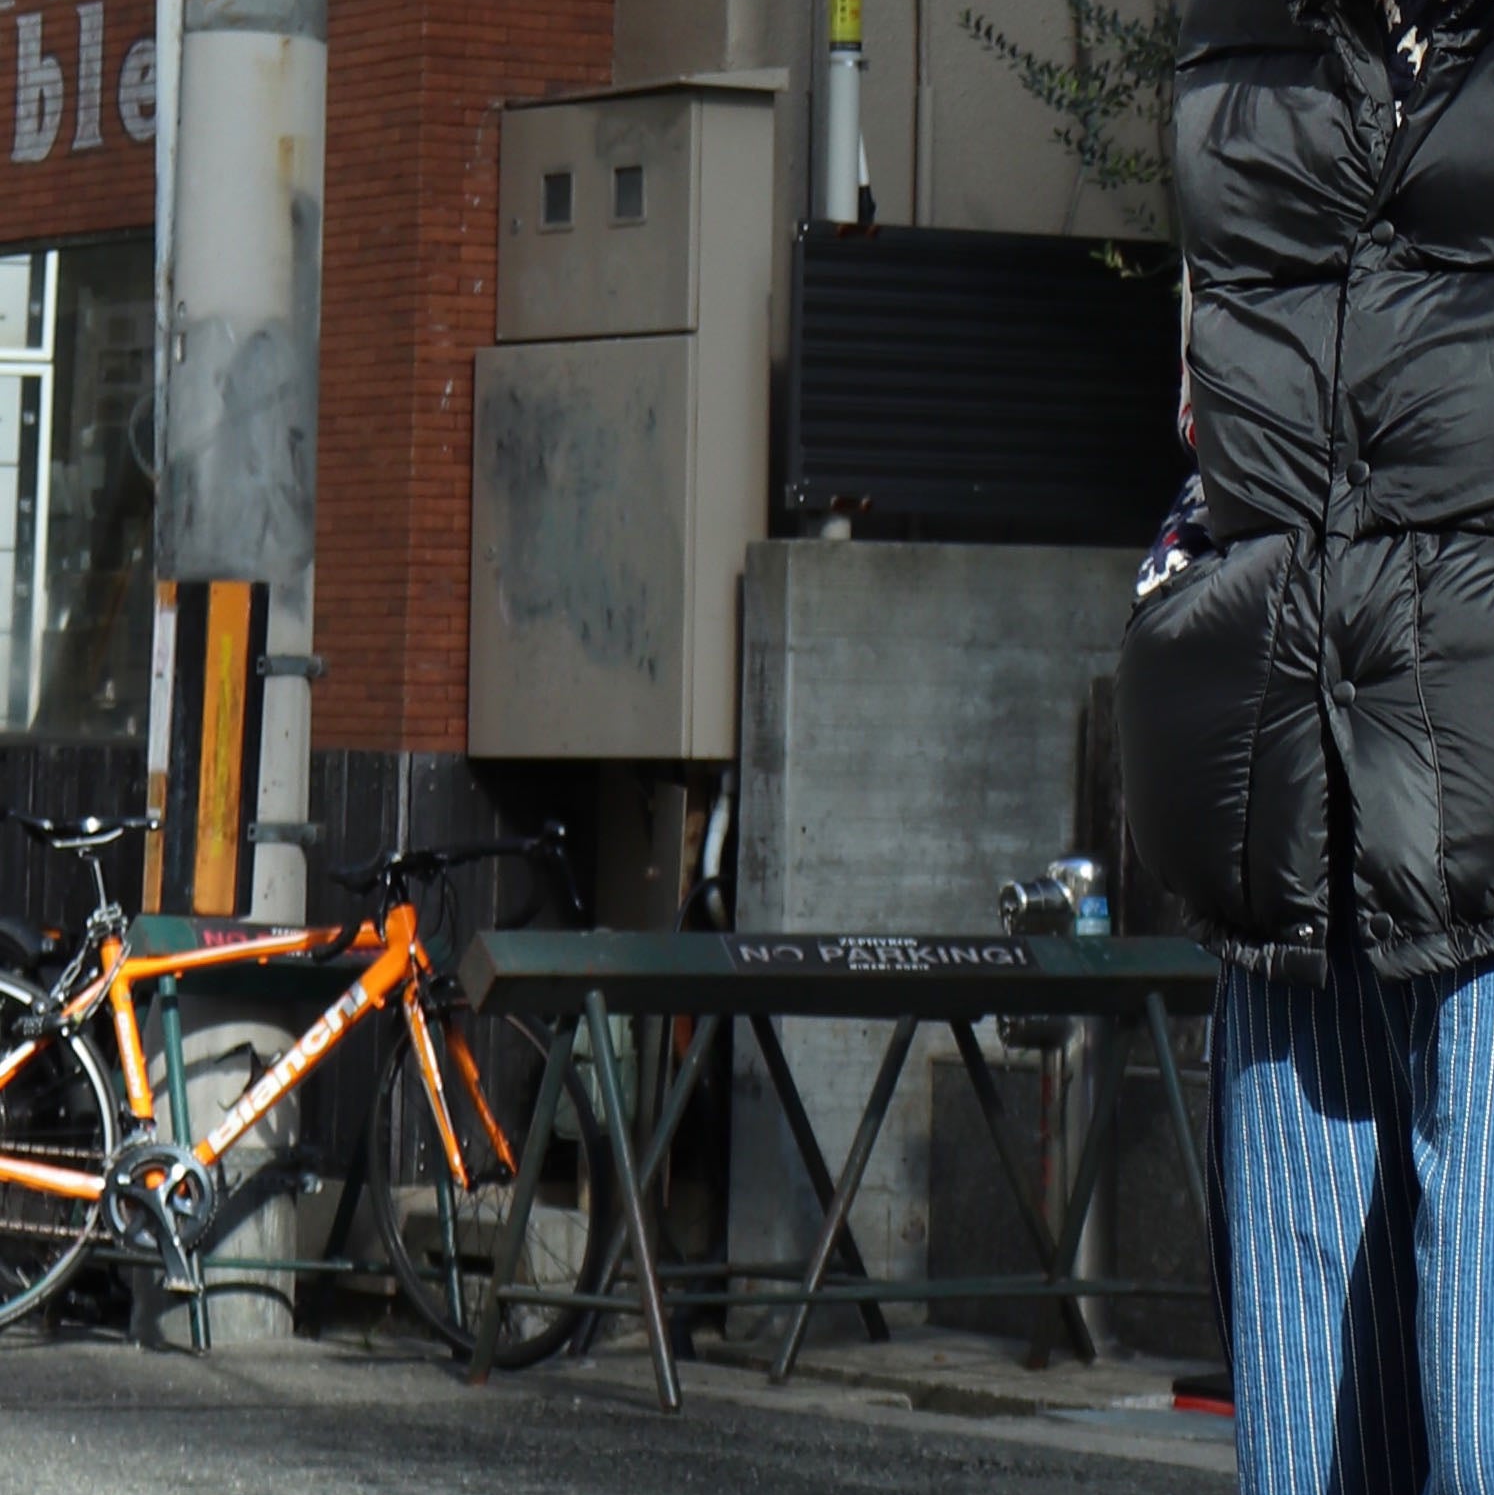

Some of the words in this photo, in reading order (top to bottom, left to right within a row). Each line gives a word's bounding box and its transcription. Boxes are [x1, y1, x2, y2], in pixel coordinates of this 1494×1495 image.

[739, 944, 805, 963] NO
[817, 944, 1029, 965] PARKING!
[207, 980, 368, 1155] Bianchi
